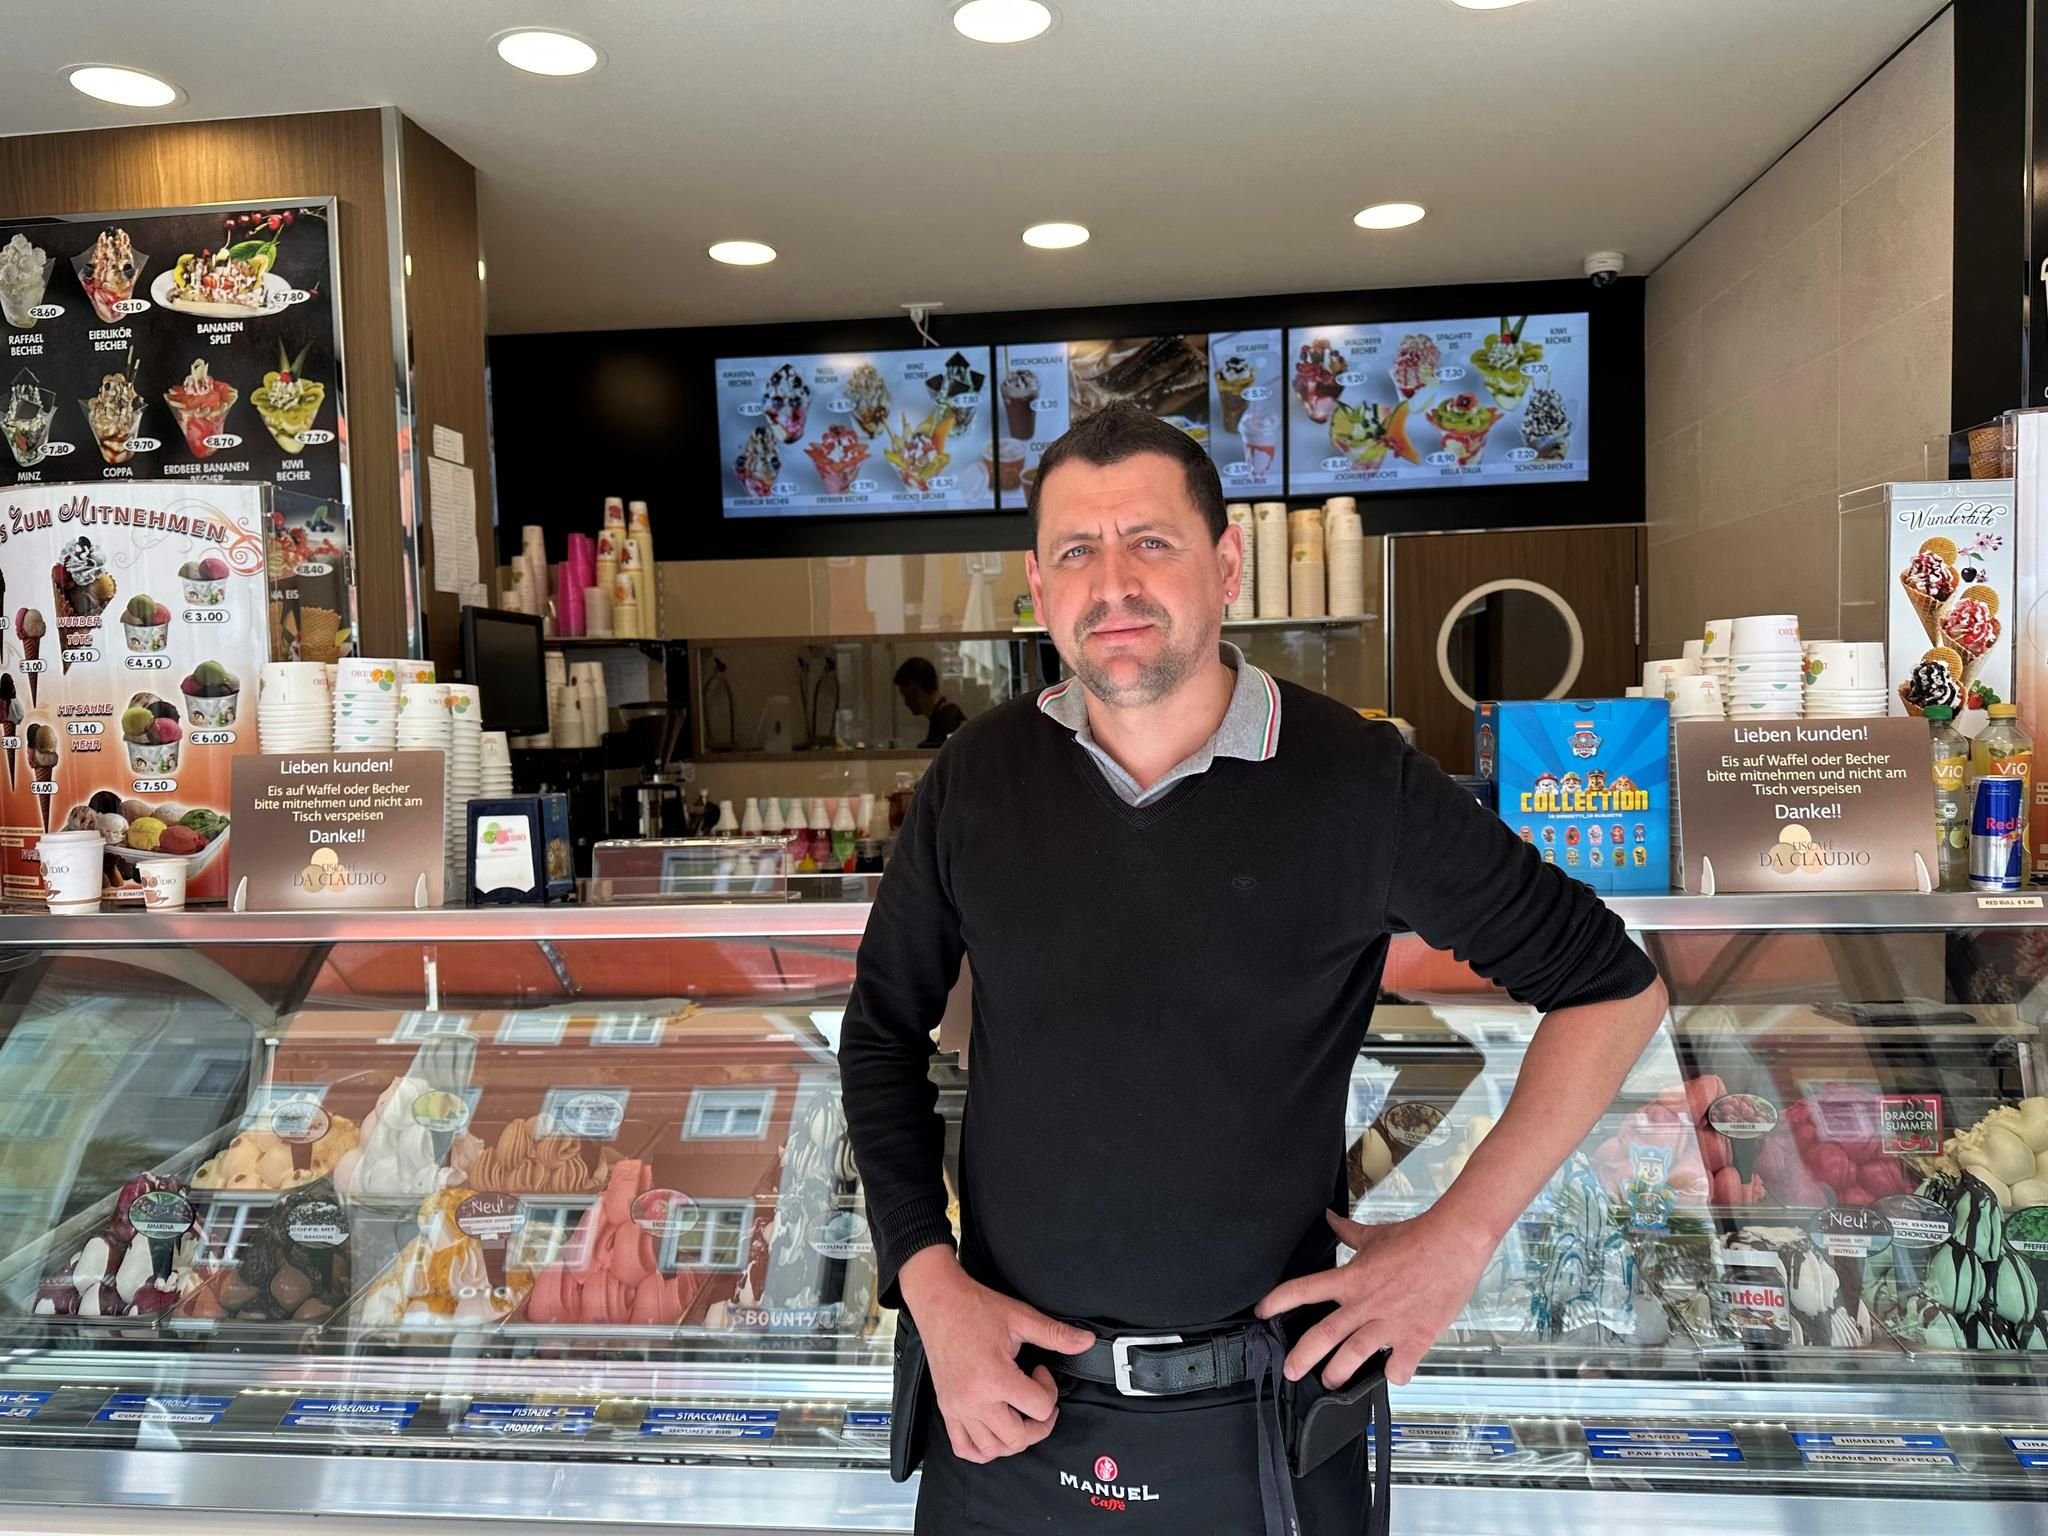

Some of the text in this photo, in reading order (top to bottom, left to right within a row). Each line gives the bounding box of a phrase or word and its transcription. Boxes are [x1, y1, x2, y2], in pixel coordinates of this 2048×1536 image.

[89, 327, 132, 340] EIERLIKÖR
[197, 322, 243, 334] BANANEN
[8, 334, 44, 345] RAFFAEL
[94, 339, 128, 351] BECHER
[210, 334, 232, 345] SPLIT
[10, 345, 43, 356] BECHER
[164, 462, 249, 474] ERDBEER BANANEN
[282, 460, 304, 470] KIWI
[17, 471, 42, 481] MINZ
[103, 467, 133, 478] COPPA
[276, 470, 311, 481] BECHER
[9, 496, 228, 542] ZUM MITNEHMEN
[1899, 502, 2008, 530] Wundertüte
[57, 616, 102, 628] WUNDER
[76, 703, 113, 716] SAHNE
[1734, 726, 1868, 743] Lieben kunden!
[72, 739, 102, 752] MEHR
[1721, 753, 1890, 767] Eis auf Waffel oder Becher
[281, 759, 393, 774] Lieben kunden!
[1707, 768, 1907, 782] bitte mitnehmen und nicht am
[268, 782, 410, 796] Eis auf Waffel oder Becher
[1752, 783, 1861, 797] Tisch verspeisen
[254, 796, 422, 810] bitte mitnehmen und nicht am
[1521, 791, 1649, 812] COLLECTION
[292, 810, 383, 823] Tisch verspeisen
[1775, 804, 1841, 819] Danke!!
[1986, 818, 2015, 830] Red
[309, 829, 365, 844] Danke!!
[1760, 850, 1871, 867] DA CLAUDIO
[293, 871, 386, 887] DA CLAUDIO
[1885, 1112, 1933, 1123] DRAGON
[1886, 1121, 1933, 1132] SUMMER
[472, 1199, 504, 1214] Neu!
[1830, 1212, 1867, 1229] Neu!
[1912, 1222, 1946, 1230] BOMB
[1896, 1231, 1944, 1240] SCHOKOLADE
[1722, 1289, 1785, 1308] nutella
[746, 1310, 818, 1326] BOUNTY
[329, 1404, 381, 1413] HASELNUSS
[512, 1408, 552, 1417] PISTAZIE
[676, 1412, 747, 1422] STRACCIATELLA
[1636, 1432, 1681, 1440] MANGO
[1841, 1437, 1896, 1446] HIMBEER
[1659, 1450, 1703, 1458] PATROL
[1815, 1453, 1949, 1465] BANANE MIT NUTELLA
[1059, 1471, 1159, 1501] MANUEL
